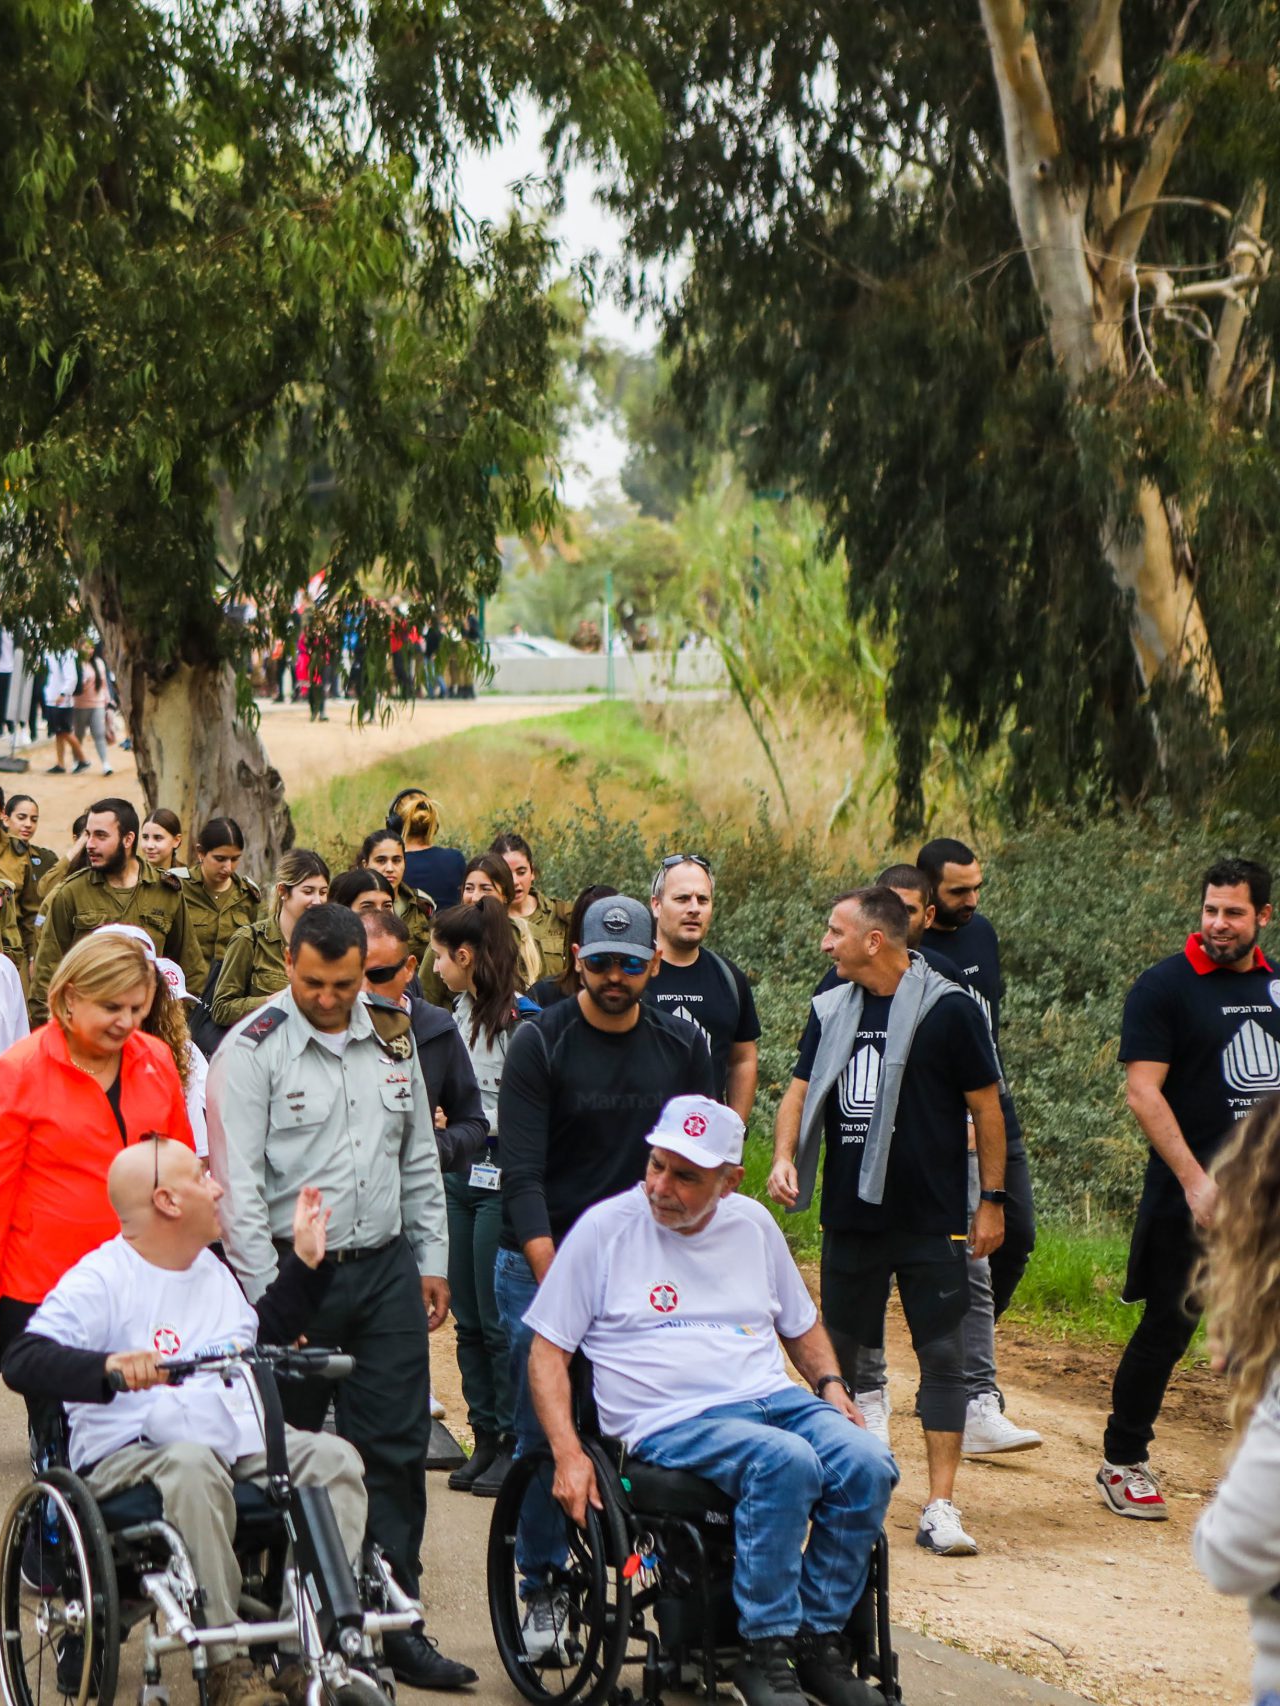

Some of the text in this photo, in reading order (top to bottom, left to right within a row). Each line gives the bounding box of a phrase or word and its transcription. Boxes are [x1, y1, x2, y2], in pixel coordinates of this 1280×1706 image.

[657, 994, 704, 1003] משרד הביטחון
[1222, 1005, 1272, 1015] משרד הביטחון
[854, 1122, 869, 1132] לנכי
